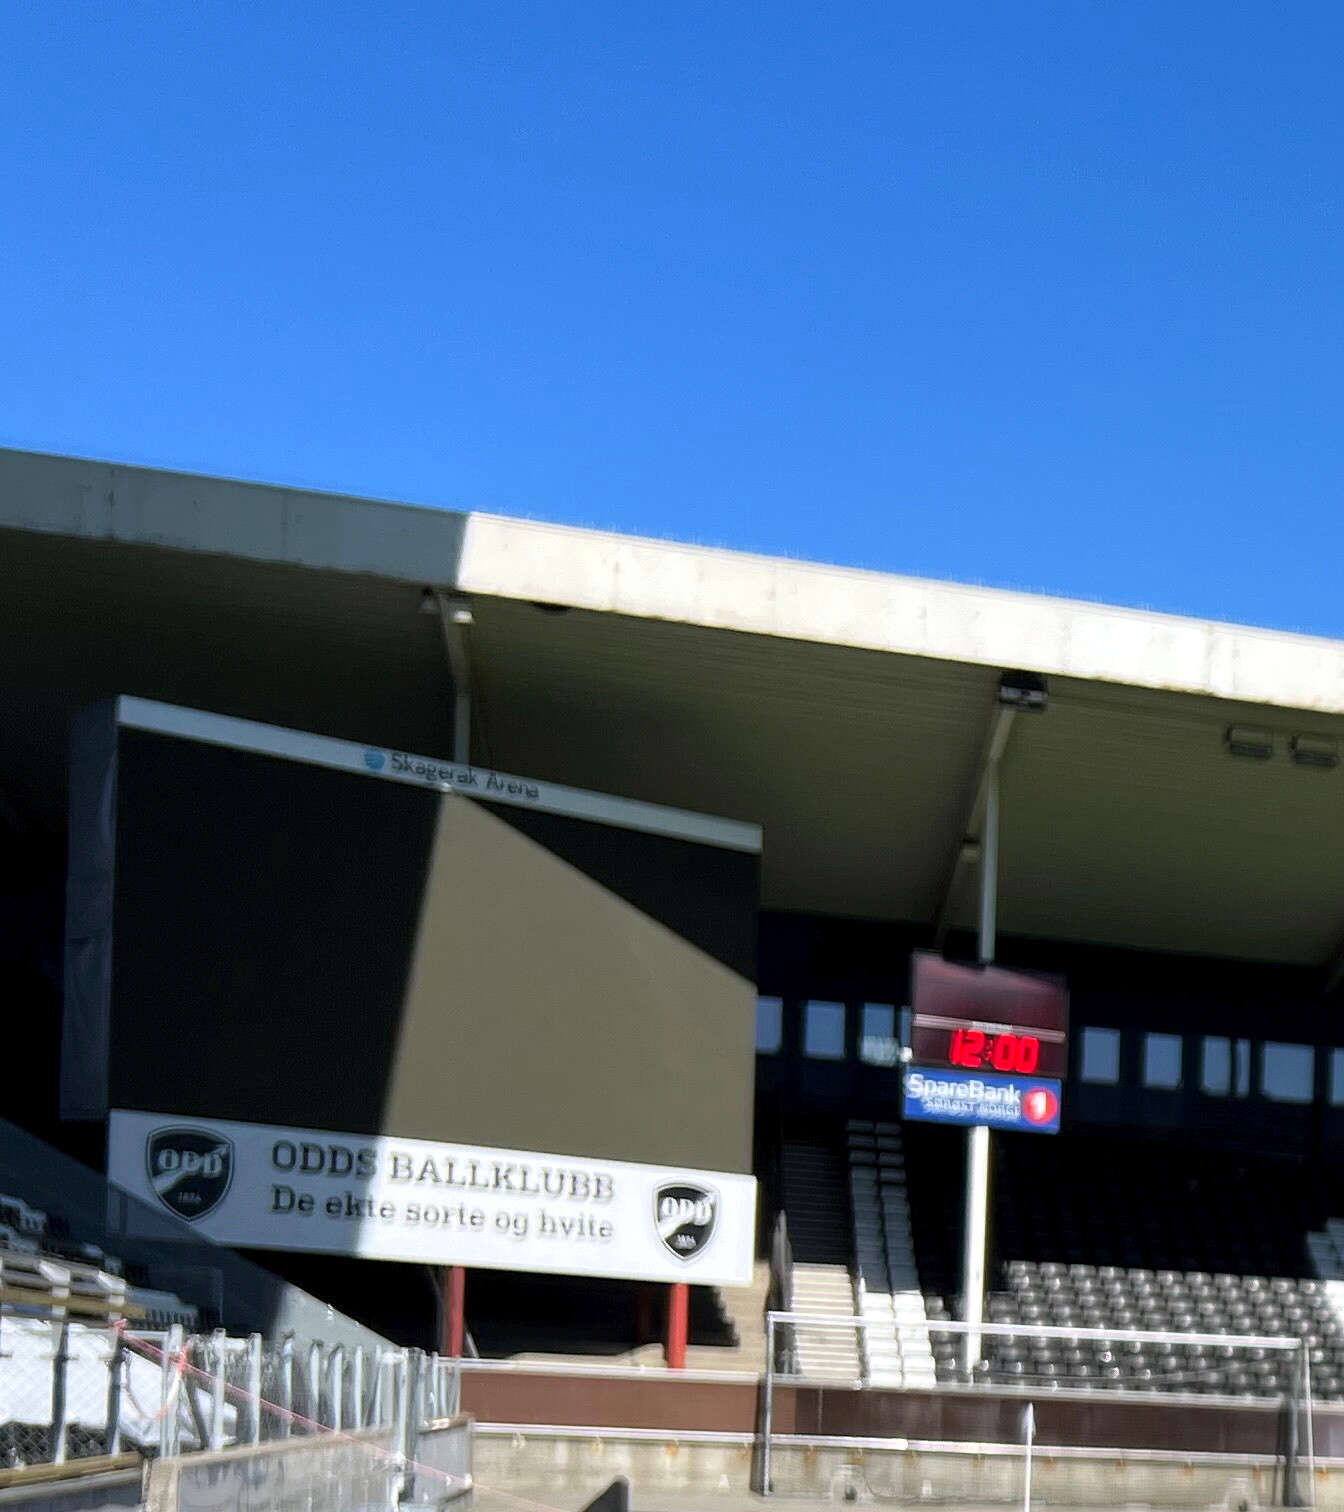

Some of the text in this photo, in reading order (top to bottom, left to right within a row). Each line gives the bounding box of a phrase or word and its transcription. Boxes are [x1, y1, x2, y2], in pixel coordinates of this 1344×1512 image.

[391, 752, 540, 799] Skagerak Arena
[952, 1029, 1040, 1074] 12:00
[908, 1073, 1021, 1104] SpareBank
[271, 1139, 615, 1203] ODDS BALLKLUBB
[271, 1184, 615, 1239] De ekte sorte og hvite
